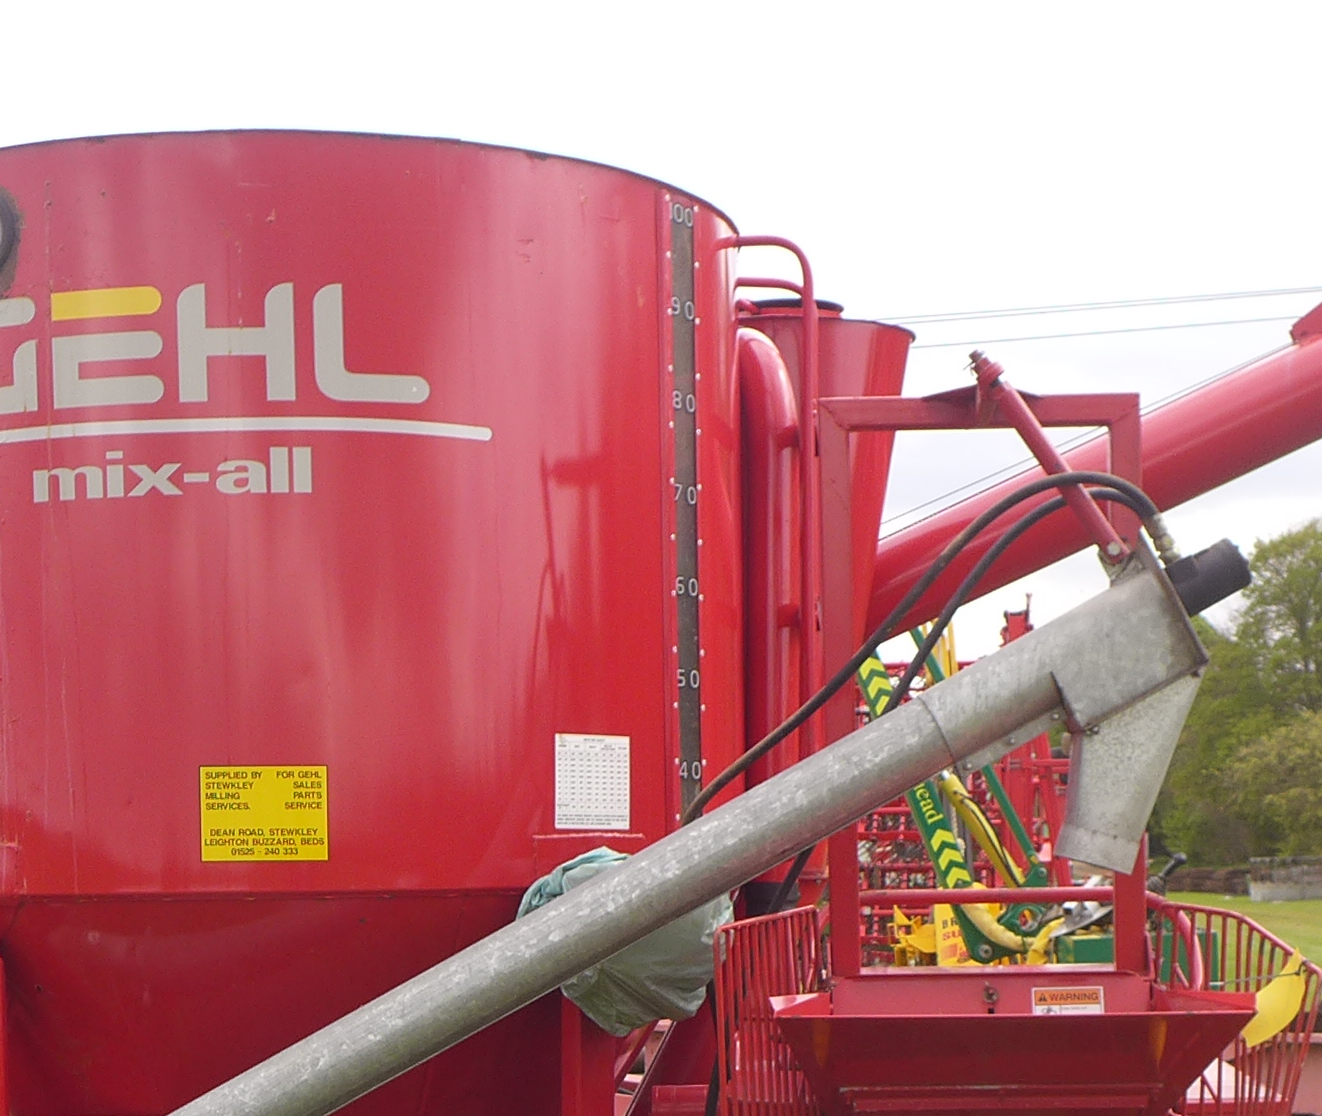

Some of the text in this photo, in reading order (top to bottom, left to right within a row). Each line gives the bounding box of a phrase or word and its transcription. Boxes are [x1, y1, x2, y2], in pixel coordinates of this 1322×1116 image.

[671, 296, 695, 321] 90
[673, 391, 696, 413] 80
[33, 446, 313, 503] mix-all
[674, 483, 697, 505] 70
[676, 576, 698, 597] 60
[677, 668, 700, 689] 50
[679, 761, 702, 780] 40
[205, 771, 262, 779] SUPPLIED BY
[205, 782, 254, 790] STEWKLEY
[293, 781, 322, 789] SALES
[205, 792, 240, 800] MILLING
[293, 791, 322, 799] PARTS
[269, 828, 318, 836] STEWKLEY
[204, 838, 249, 846] LEIGHTON
[231, 848, 255, 856] 01525
[1049, 992, 1098, 1001] WARNING
